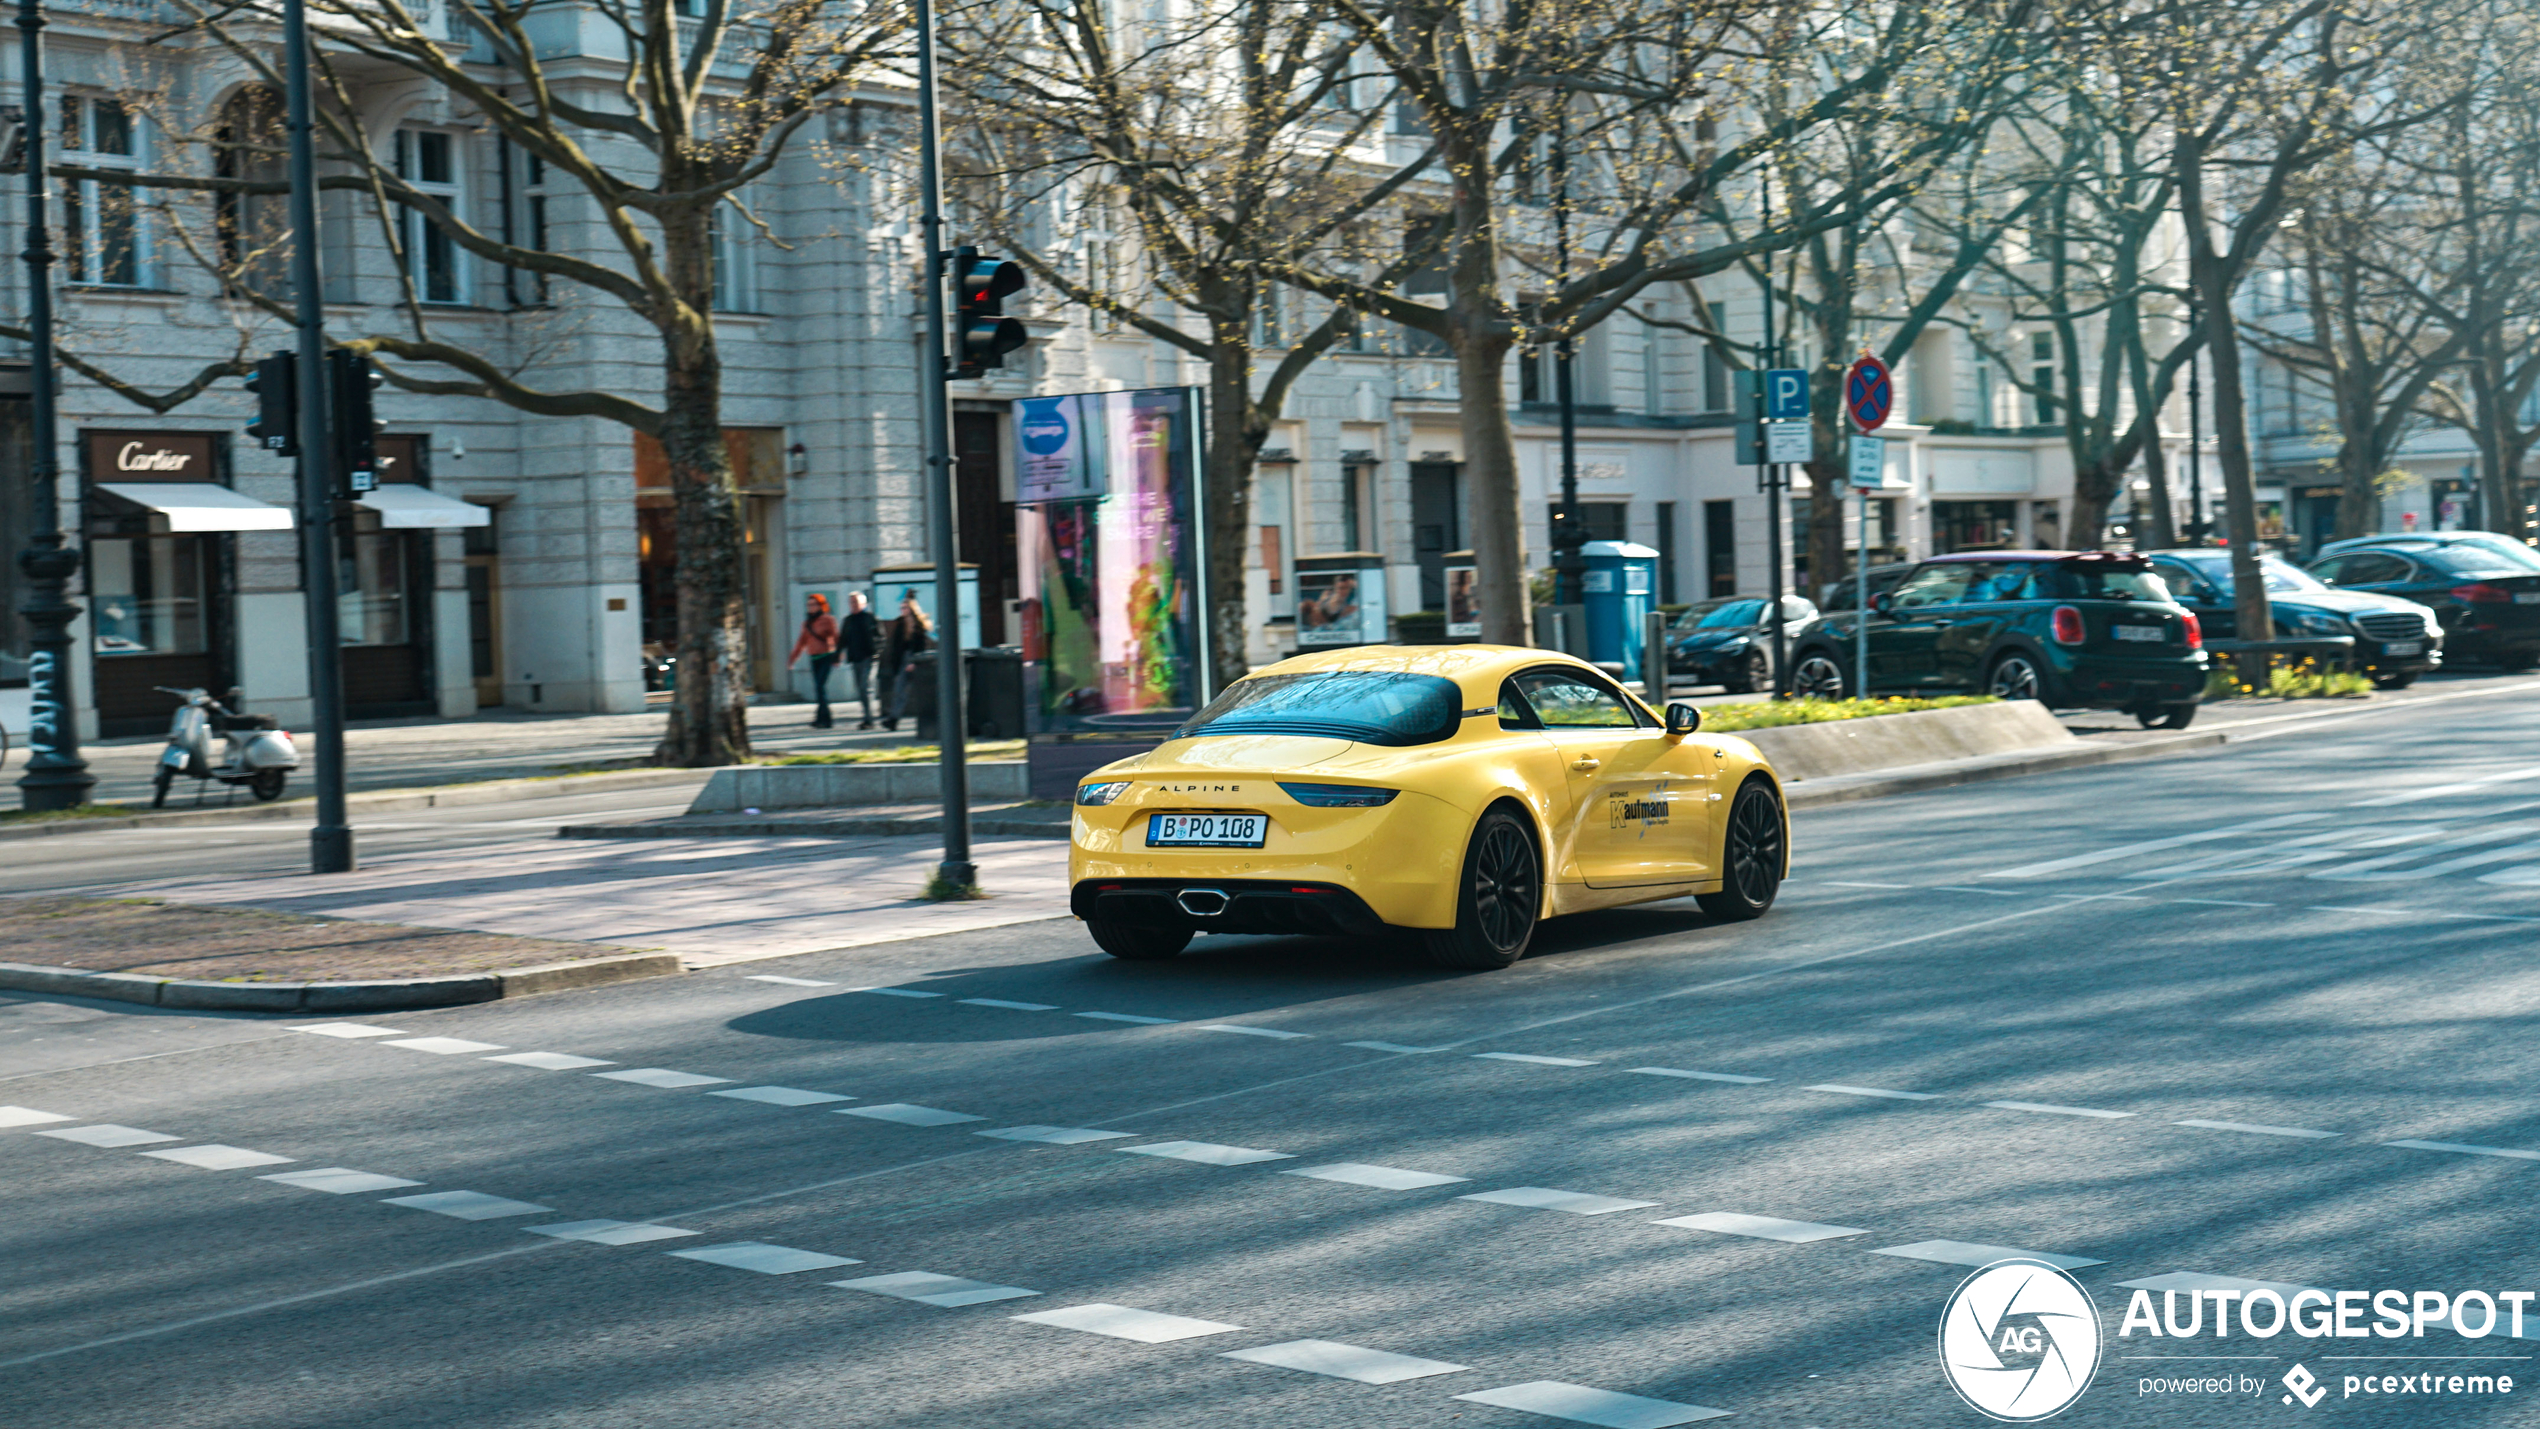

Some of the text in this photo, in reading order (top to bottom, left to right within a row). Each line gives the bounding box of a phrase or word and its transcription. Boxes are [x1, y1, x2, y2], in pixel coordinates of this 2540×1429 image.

[1776, 376, 1799, 412] P
[118, 441, 191, 471] Cartier
[1163, 818, 1255, 838] B PO 108
[1609, 799, 1669, 829] Kaufmann
